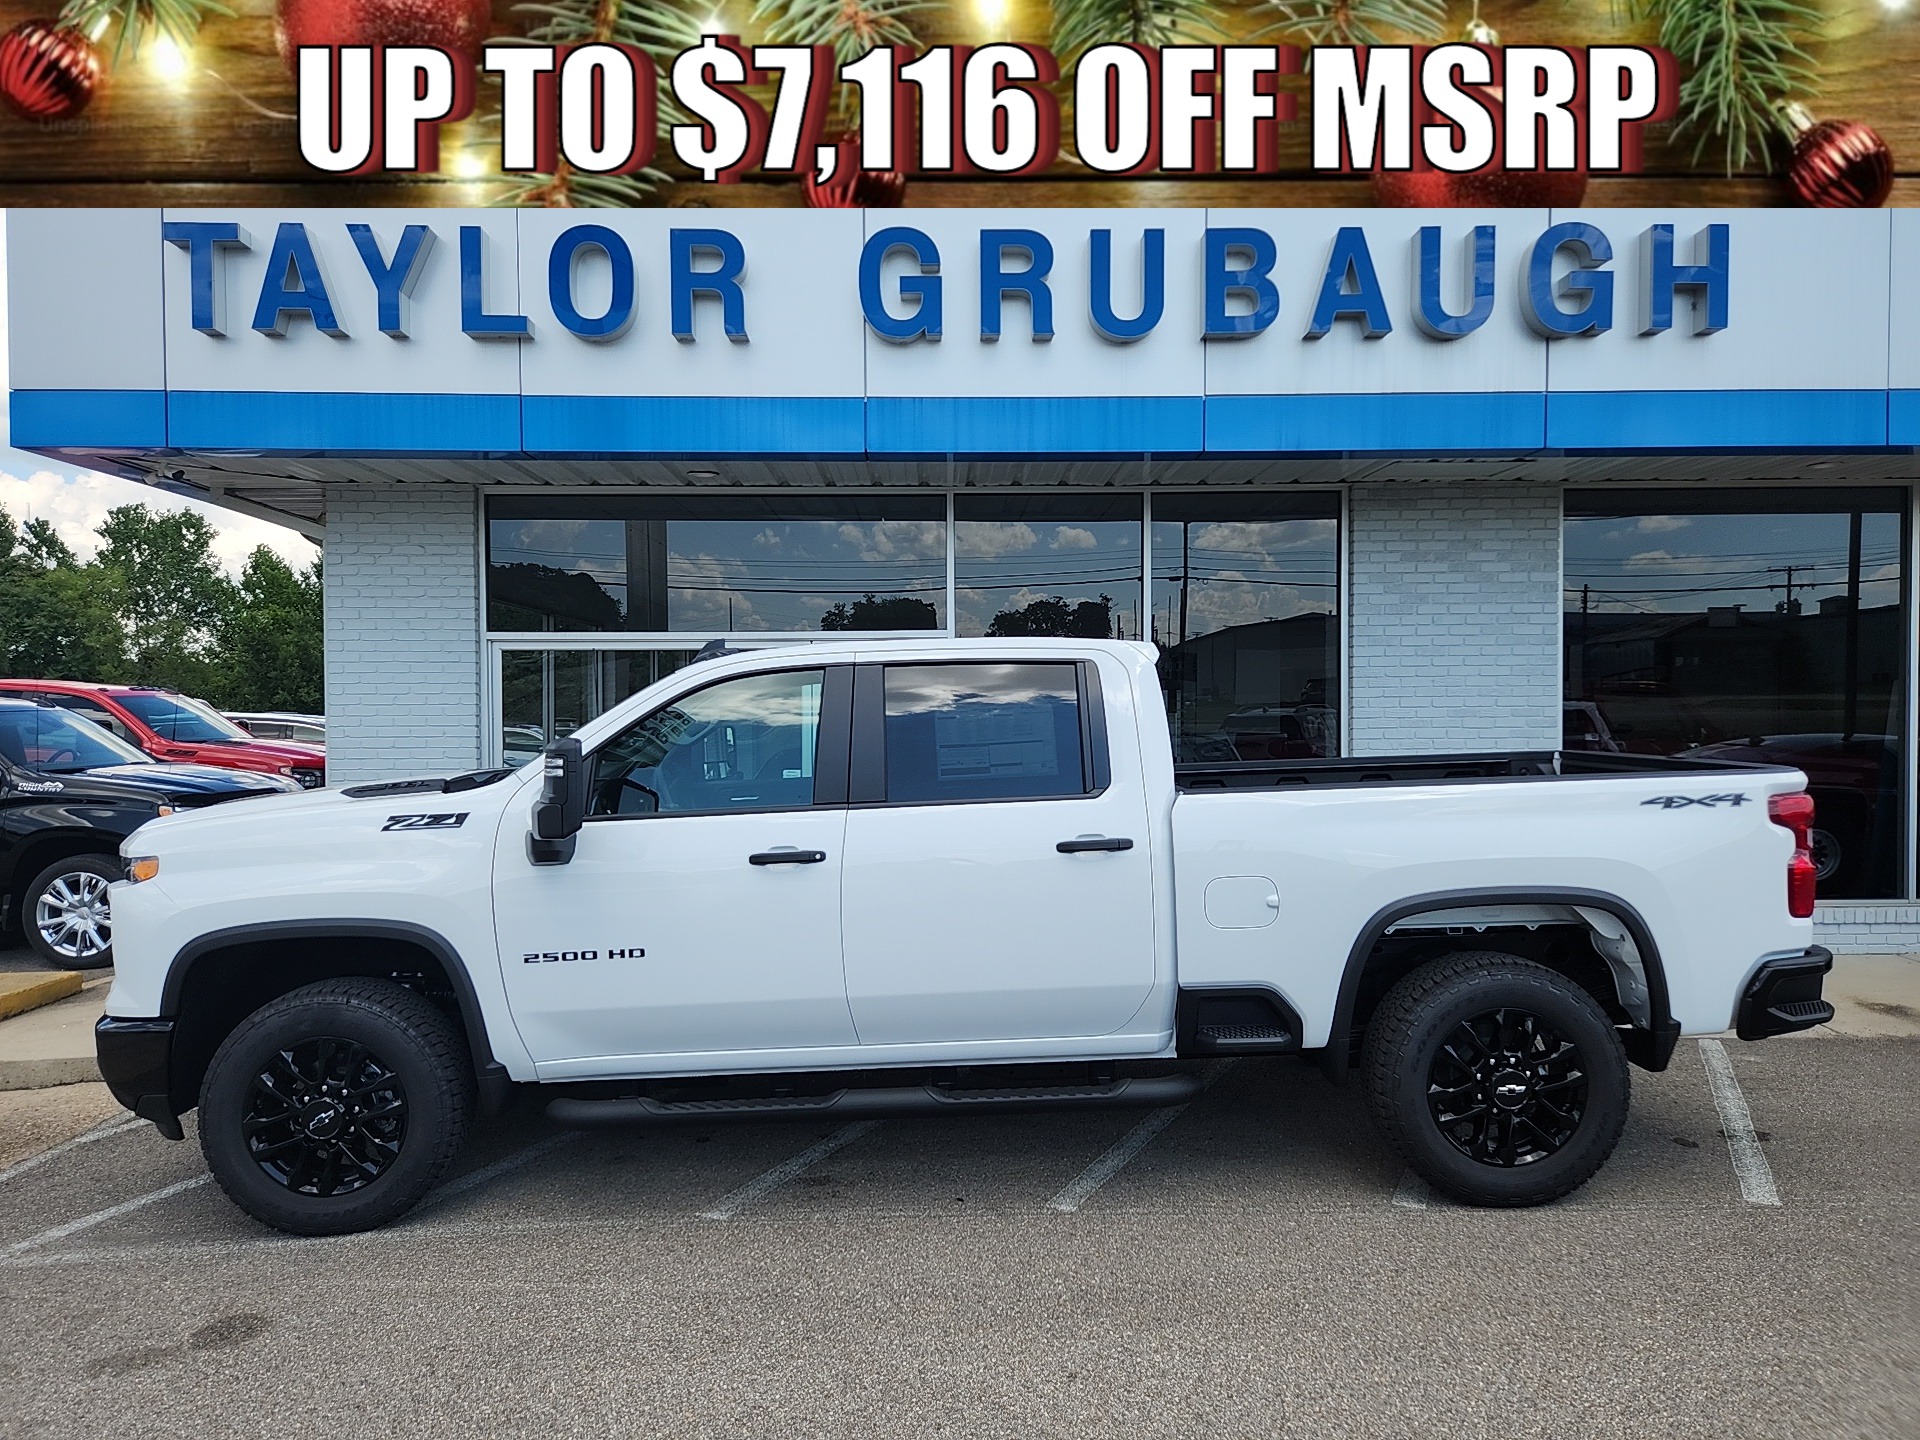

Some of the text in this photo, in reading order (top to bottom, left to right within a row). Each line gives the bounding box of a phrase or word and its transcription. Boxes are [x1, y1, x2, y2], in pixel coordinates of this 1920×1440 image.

[163, 222, 1730, 343] TAYLOR GRUBAUGH
[523, 948, 645, 964] 2500 HD
